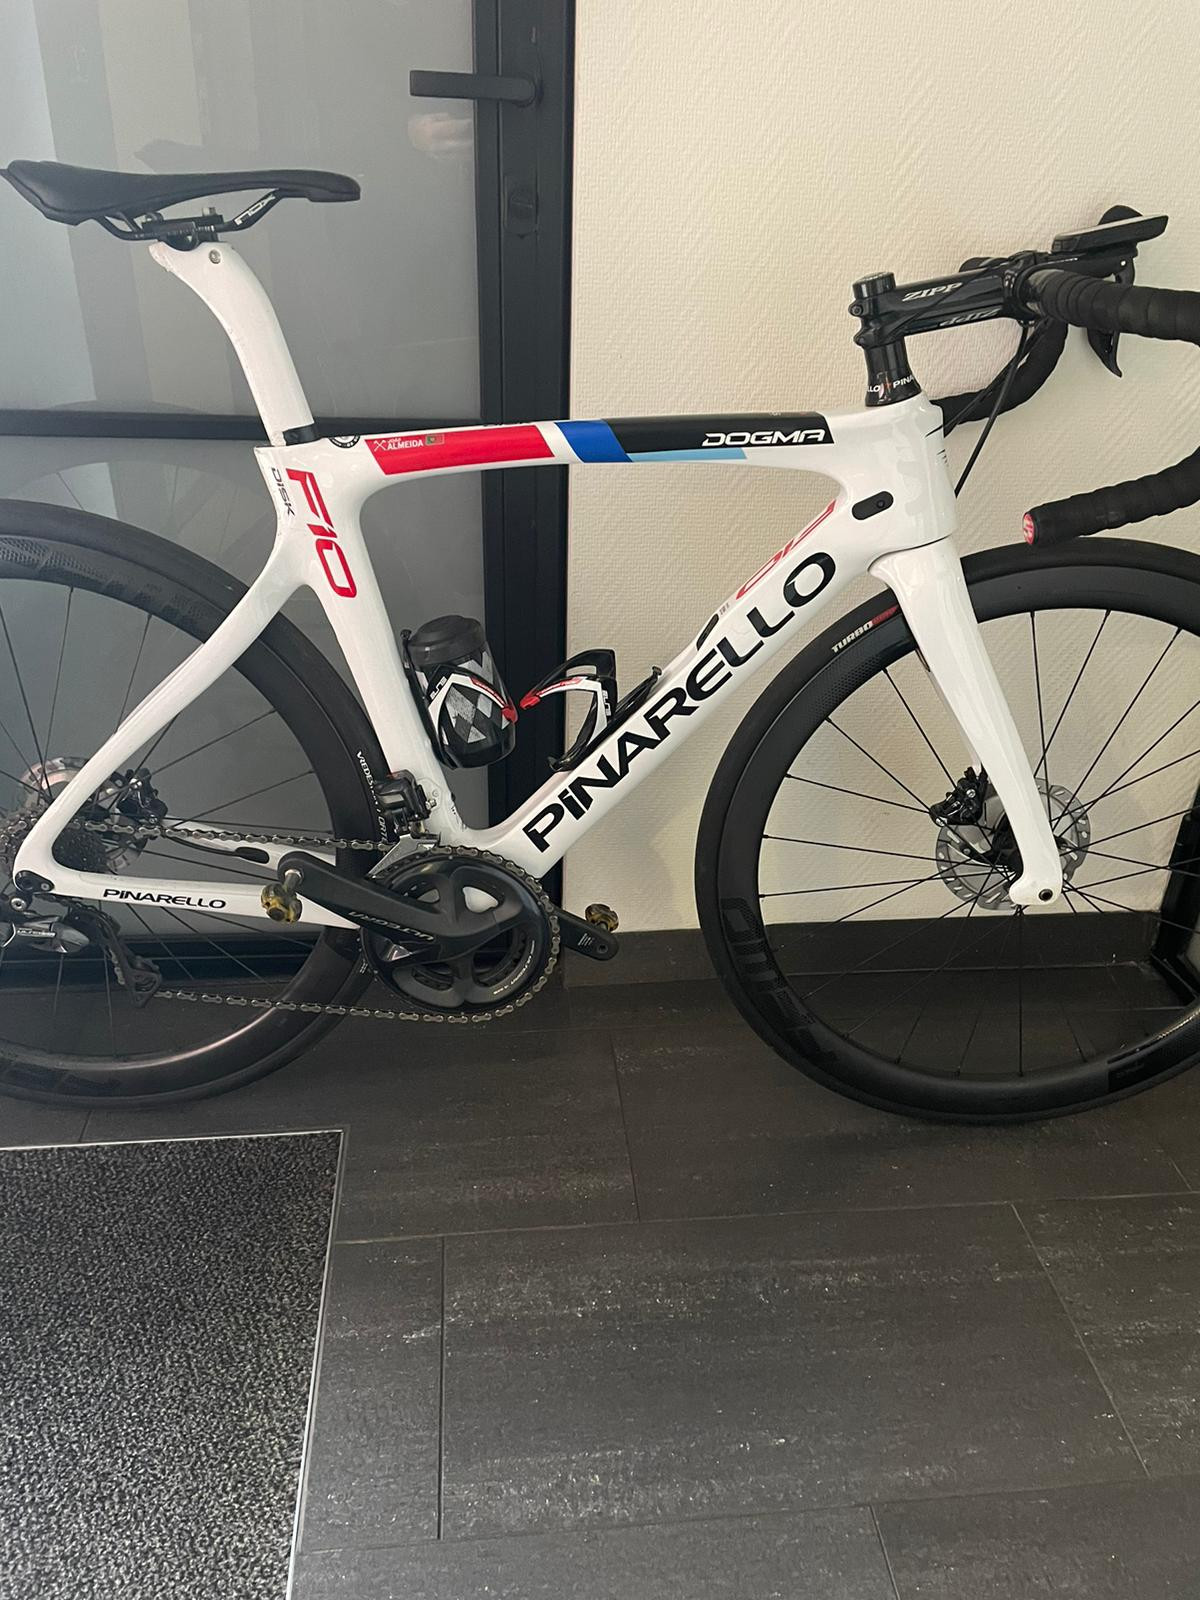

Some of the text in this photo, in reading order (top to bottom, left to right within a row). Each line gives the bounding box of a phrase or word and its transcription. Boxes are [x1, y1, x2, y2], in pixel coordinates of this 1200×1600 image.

[902, 282, 963, 302] ZIPP
[386, 438, 424, 451] ALMEIDA
[701, 428, 826, 447] DOGMA
[270, 466, 296, 517] DISK
[285, 467, 358, 599] F10
[830, 620, 875, 654] TURBO
[521, 551, 837, 854] PINARELLO
[102, 888, 227, 910] PINARELLO
